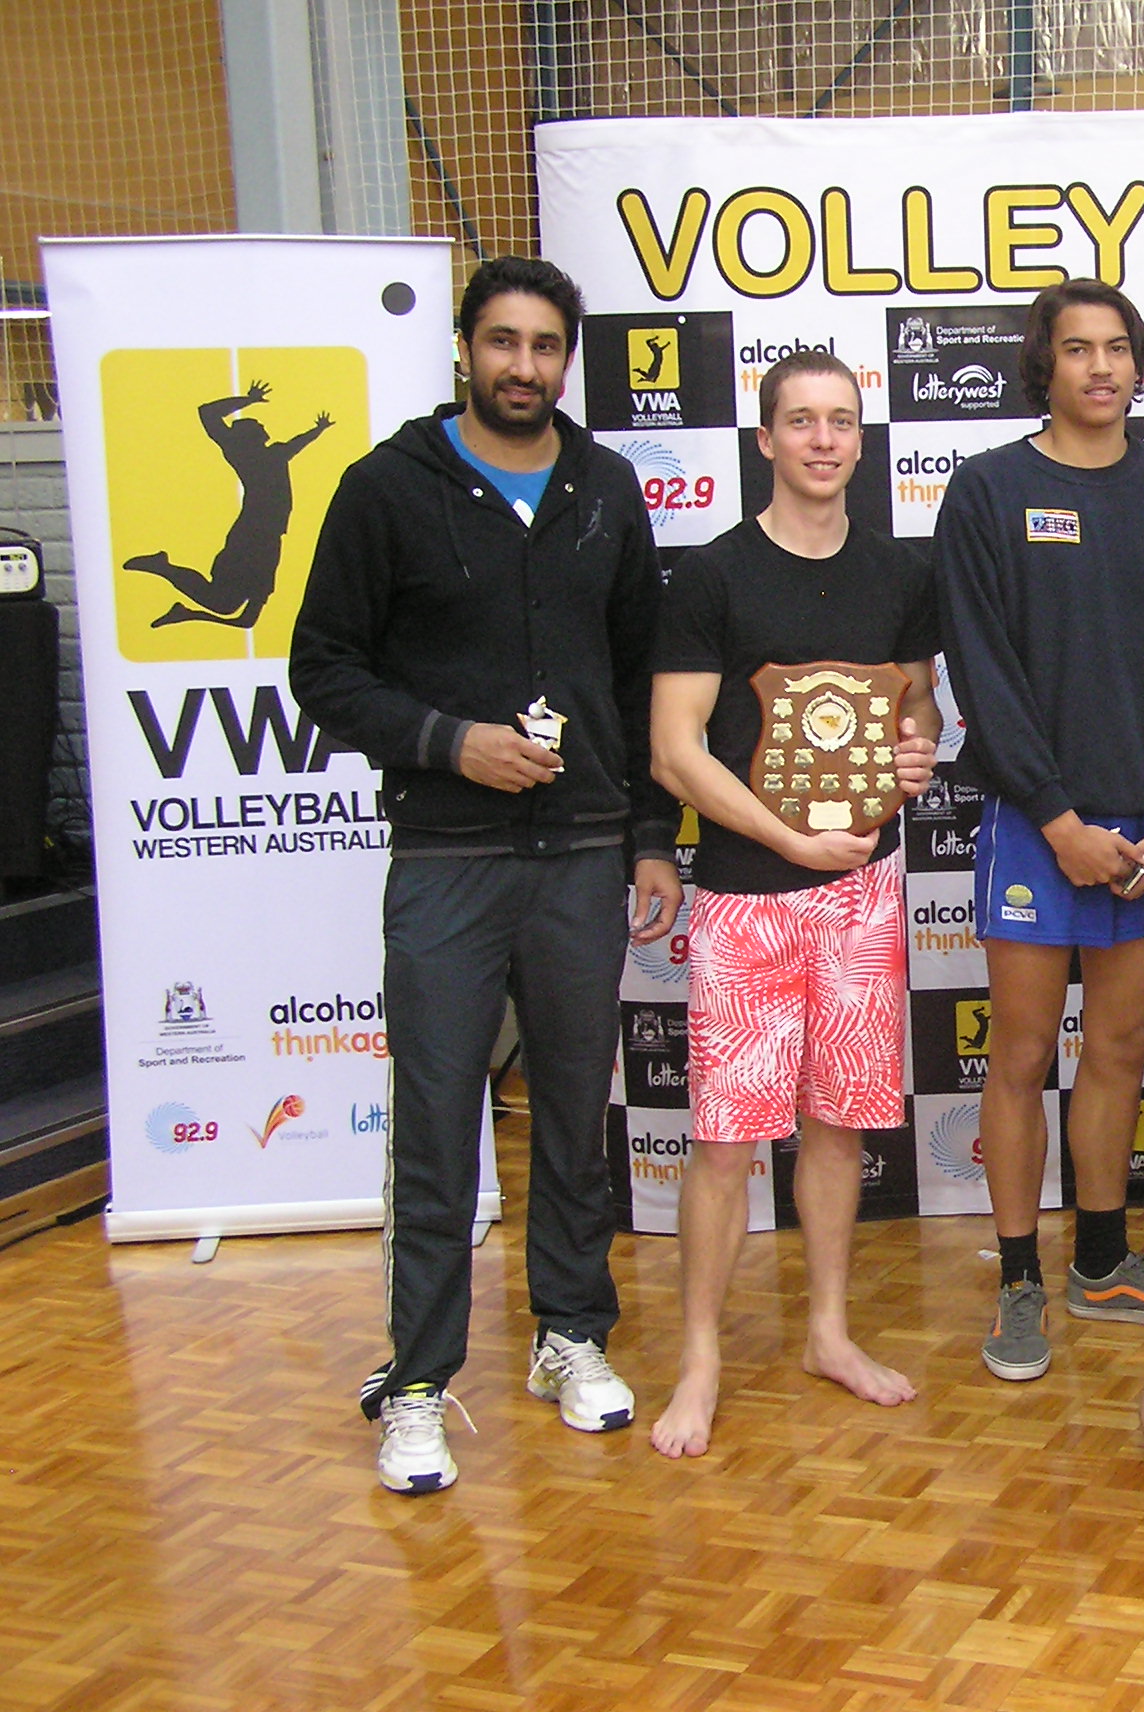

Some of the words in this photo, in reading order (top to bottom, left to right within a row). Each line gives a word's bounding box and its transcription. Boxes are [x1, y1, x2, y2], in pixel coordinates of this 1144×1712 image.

[936, 326, 985, 336] Department
[986, 325, 996, 334] of
[936, 336, 961, 346] Sport
[963, 335, 981, 344] and
[913, 371, 1007, 405] lotterywest
[631, 391, 682, 412] VWA
[960, 401, 1000, 411] supported
[644, 476, 715, 511] 92.9
[133, 835, 257, 860] WESTERN
[270, 992, 383, 1025] alcohol
[138, 1058, 167, 1069] Sport
[169, 1056, 189, 1066] and
[191, 1054, 246, 1065] Recreation
[173, 1121, 219, 1143] 92.9
[278, 1130, 329, 1142] Volleyball
